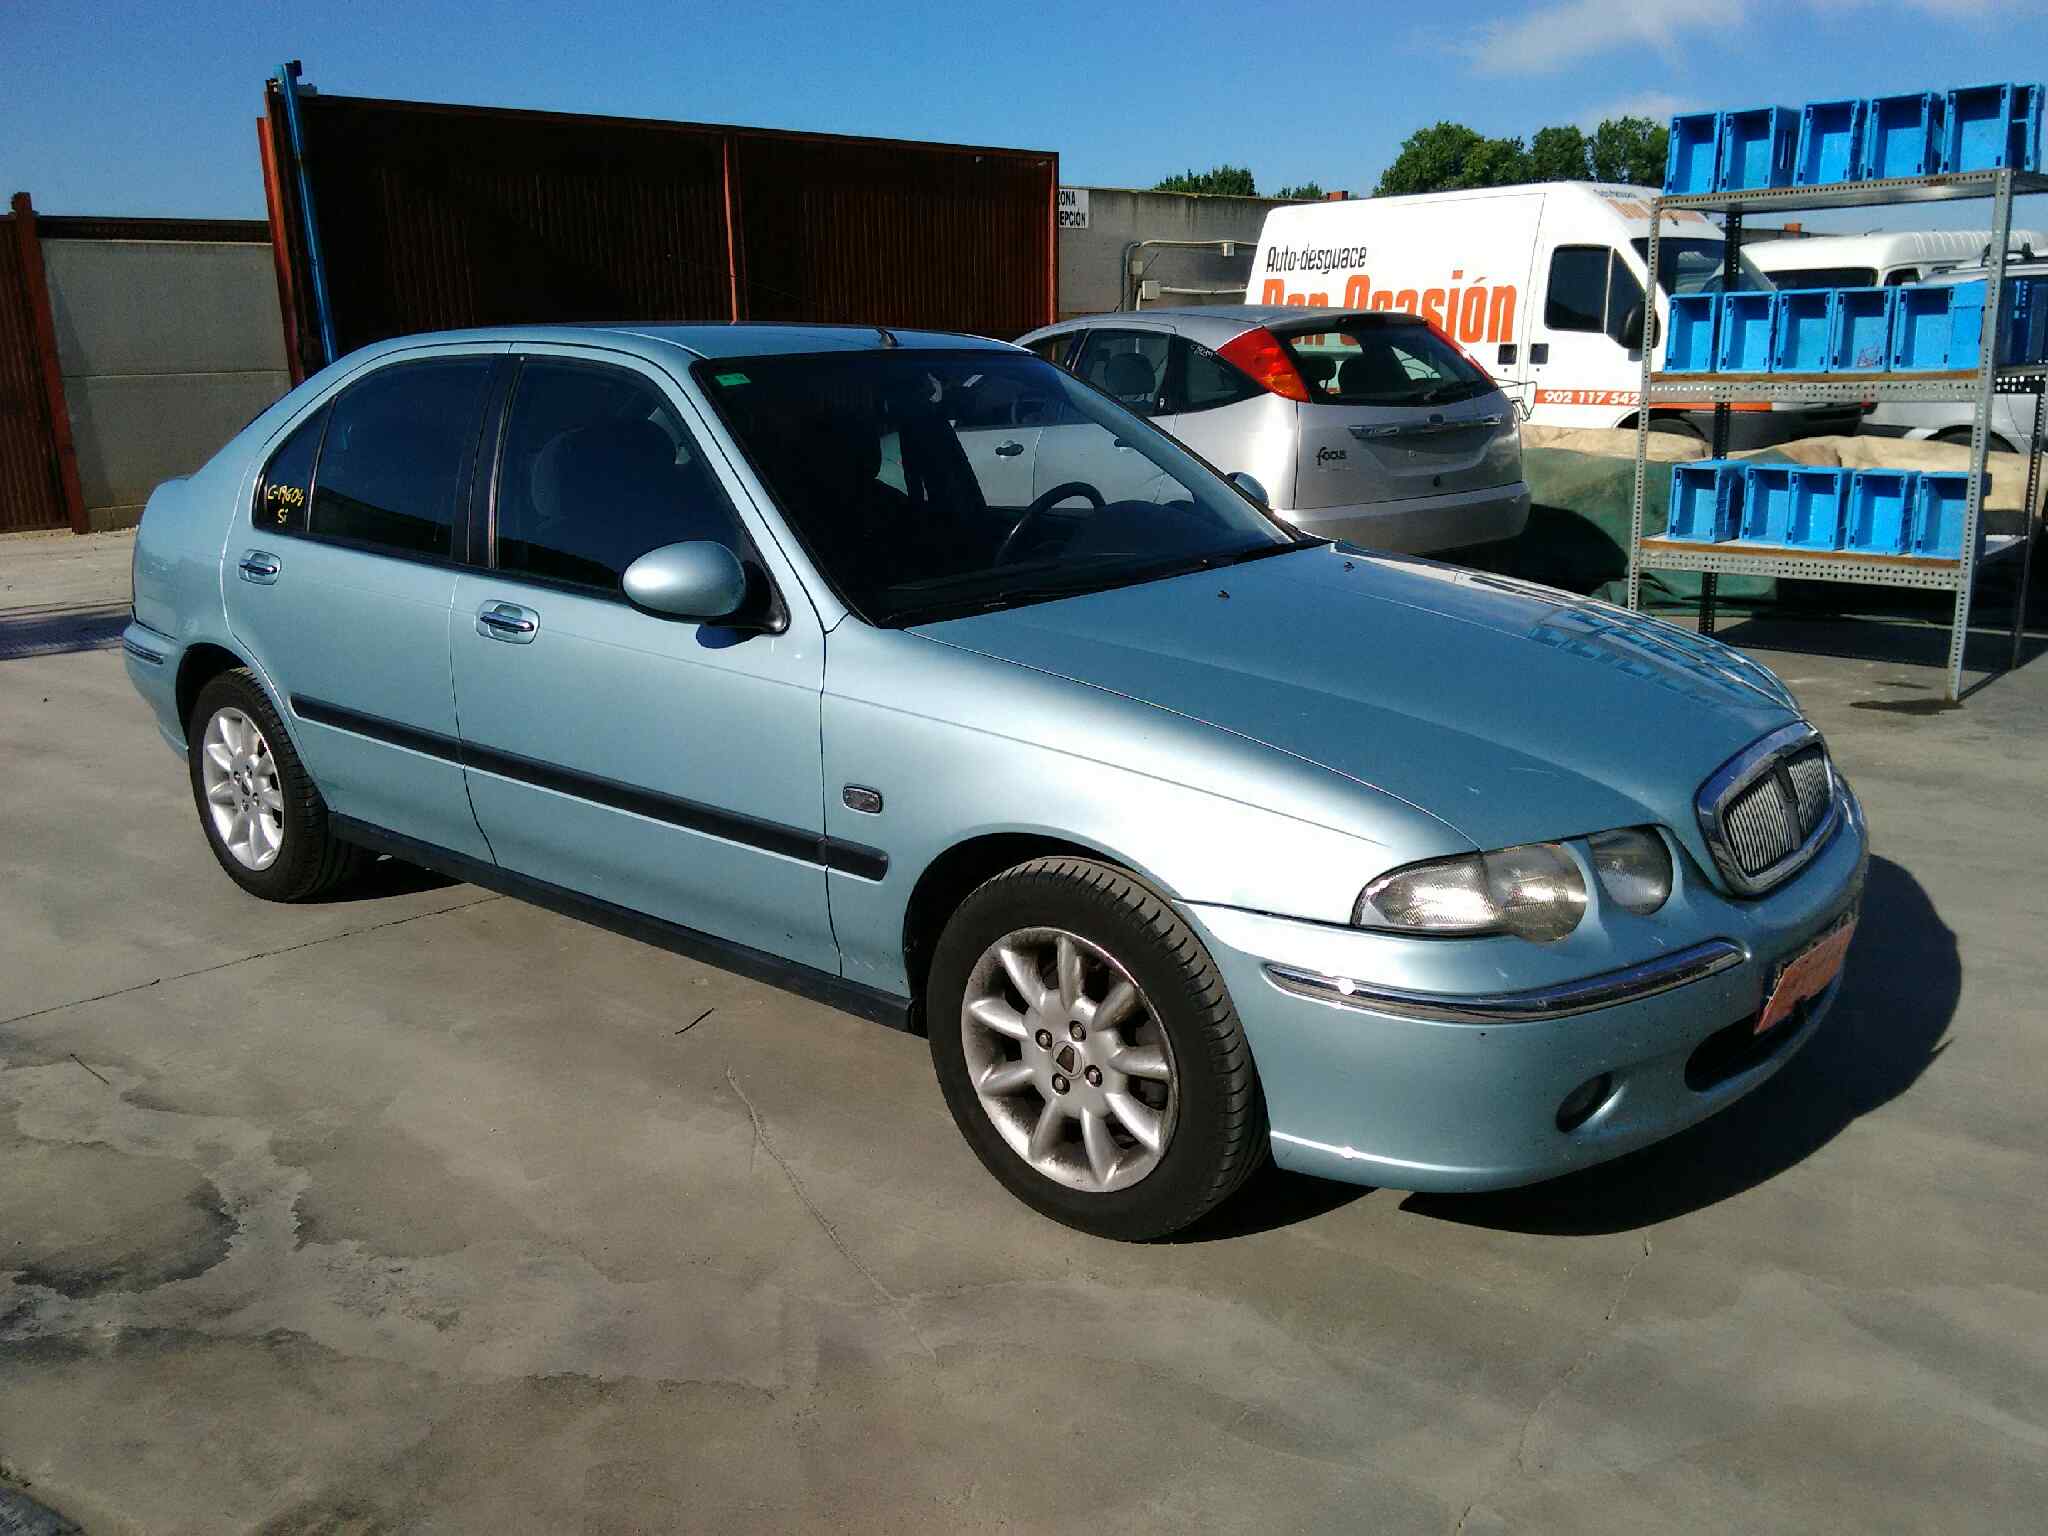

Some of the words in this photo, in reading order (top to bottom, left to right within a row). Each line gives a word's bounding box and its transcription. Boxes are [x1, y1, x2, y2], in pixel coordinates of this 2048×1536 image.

[1058, 190, 1076, 206] ONA
[1266, 243, 1367, 275] Auto-desguace
[1544, 391, 1573, 403] 902
[1579, 391, 1604, 404] 117
[1609, 392, 1640, 405] 542
